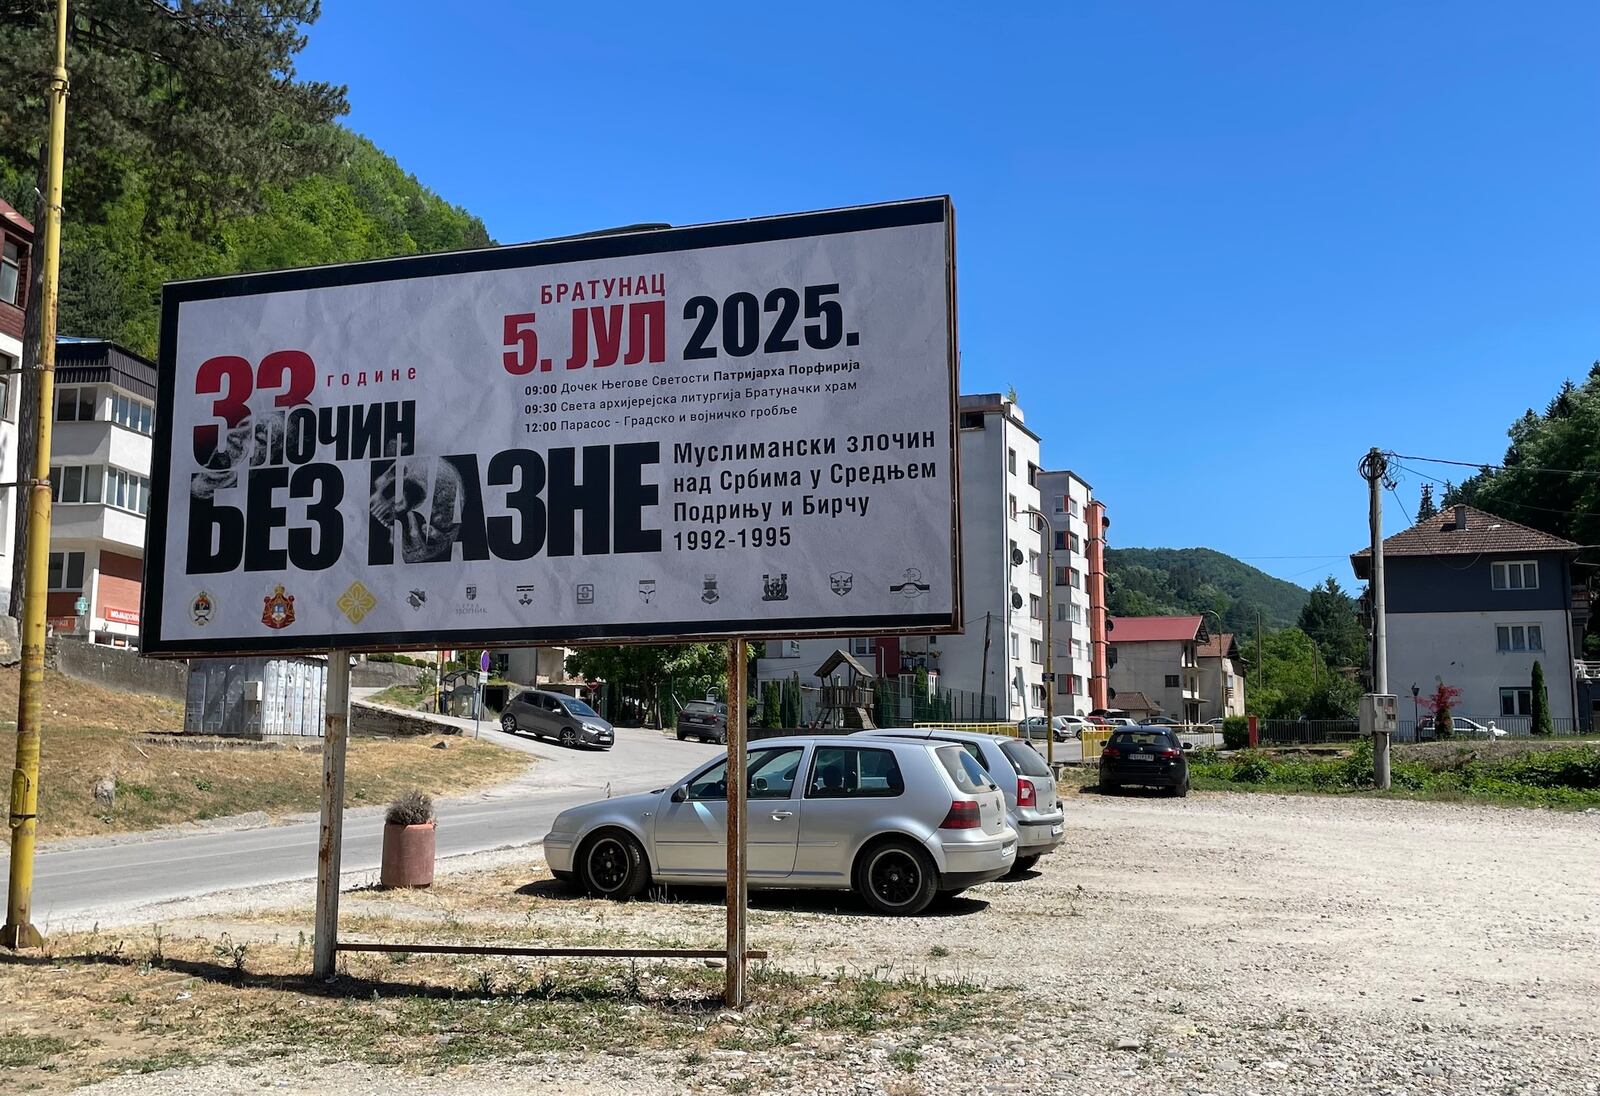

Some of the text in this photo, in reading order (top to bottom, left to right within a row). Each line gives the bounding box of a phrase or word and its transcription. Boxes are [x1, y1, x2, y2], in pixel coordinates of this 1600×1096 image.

[541, 273, 666, 305] БРАТУНАЦ
[503, 283, 860, 376] 5. ЈУЛ 2025.
[327, 367, 417, 387] године
[525, 360, 861, 396] 09:00 Дочек Његове Светости Патријарха Порфирија
[525, 381, 858, 415] 09:30 Света архијерејска литургија Братуначки храм
[525, 421, 557, 433] 12:00
[561, 418, 611, 432] Парасос
[624, 414, 675, 429] Градско
[679, 414, 687, 423] и
[691, 409, 746, 424] војничко
[750, 405, 798, 419] гробље
[673, 431, 936, 468] Муслимански злочин
[673, 461, 937, 494] над Србима у Средњем
[185, 440, 663, 575] БЕЗ КАЗНЕ
[673, 495, 870, 524] Подрињу и Бирчу
[673, 526, 792, 551] 1992-1995
